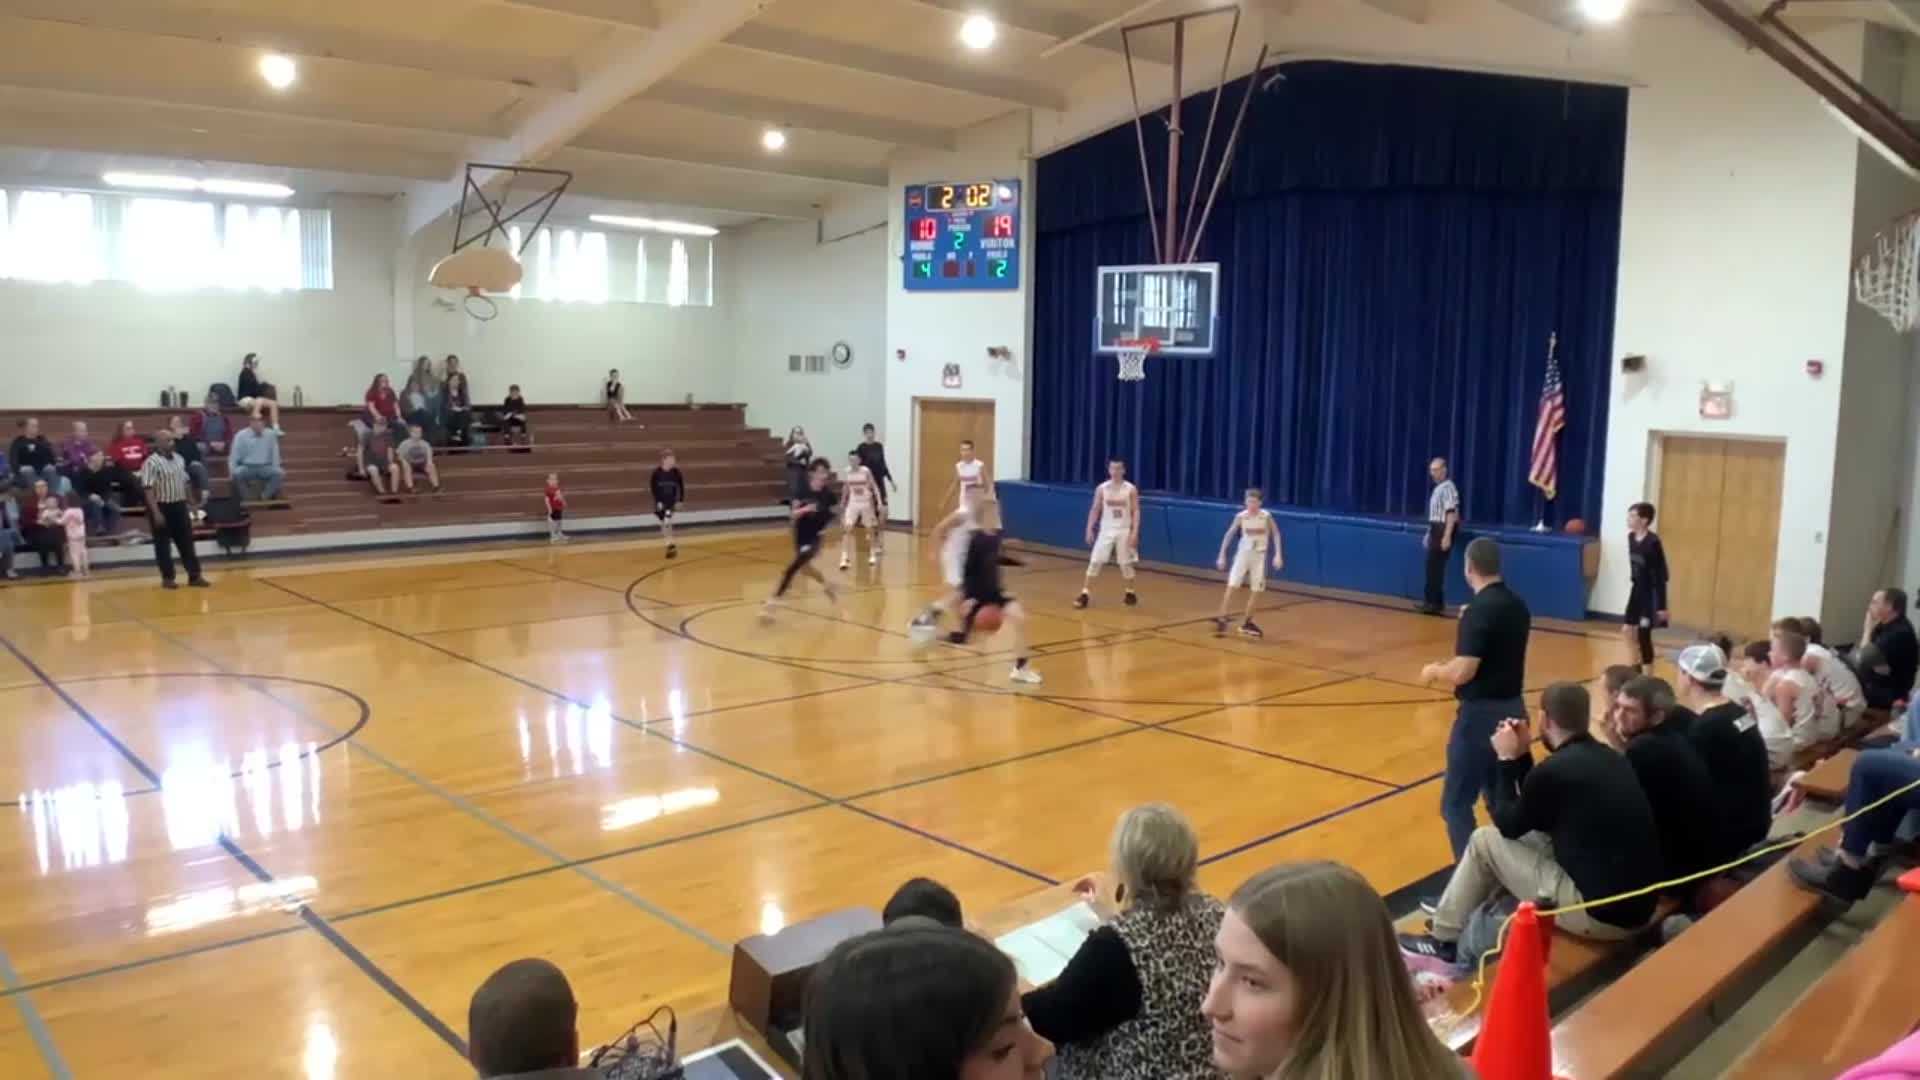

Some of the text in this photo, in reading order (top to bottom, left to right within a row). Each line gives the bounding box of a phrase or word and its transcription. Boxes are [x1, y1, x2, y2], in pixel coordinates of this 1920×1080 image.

[920, 218, 936, 239] 10
[994, 215, 1012, 236] 19
[954, 232, 964, 249] 2
[921, 261, 931, 278] 4
[995, 260, 1007, 277] 2
